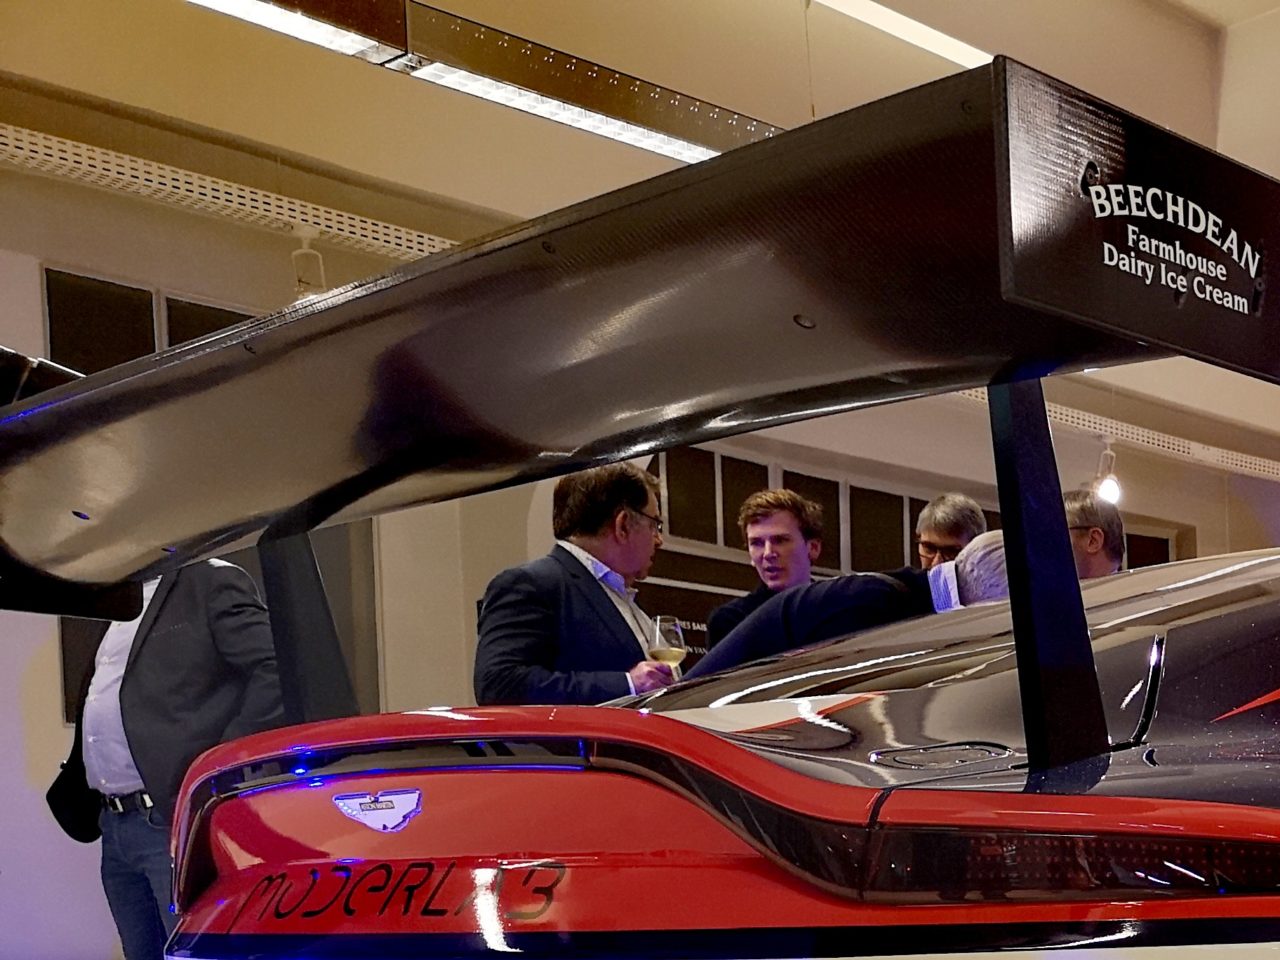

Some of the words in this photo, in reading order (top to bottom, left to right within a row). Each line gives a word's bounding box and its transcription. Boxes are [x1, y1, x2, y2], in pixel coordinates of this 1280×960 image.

[1088, 184, 1261, 279] BEECHDEAN
[1126, 223, 1227, 281] Farmhouse
[1102, 241, 1155, 285] Dairy
[1160, 262, 1188, 293] Ice
[1193, 276, 1249, 315] Cream
